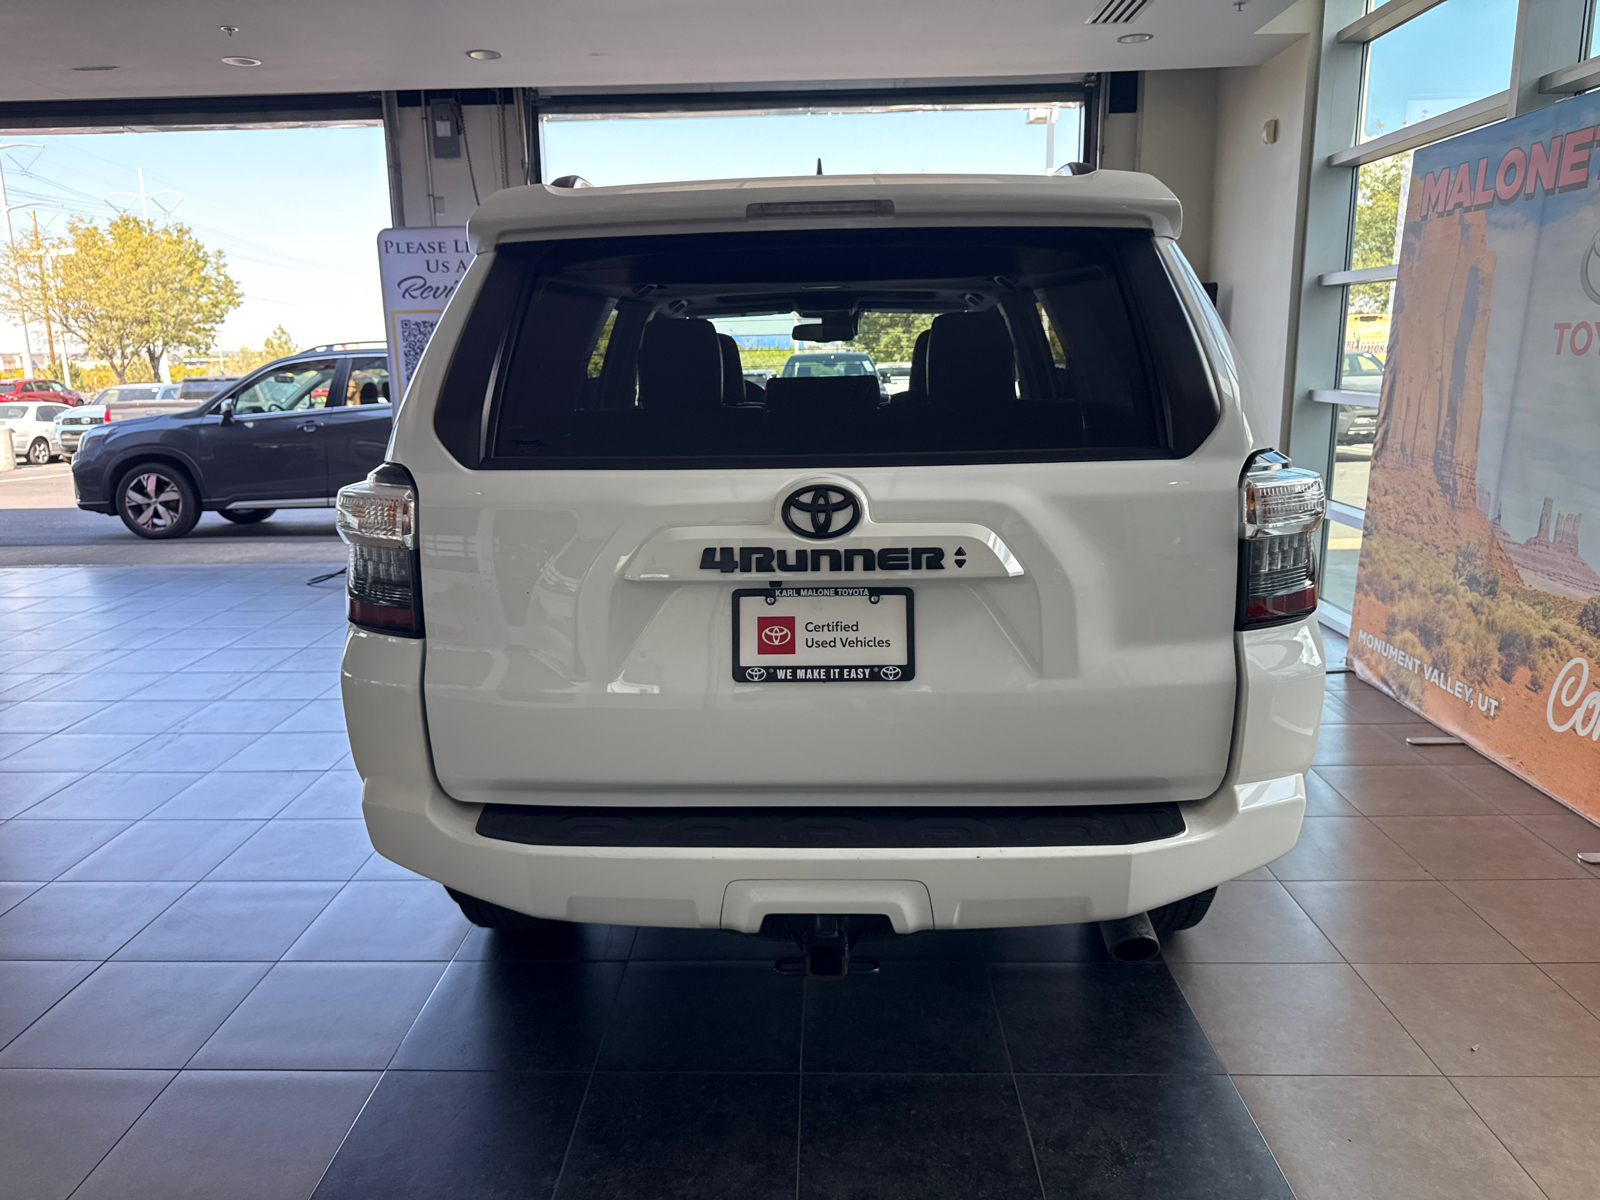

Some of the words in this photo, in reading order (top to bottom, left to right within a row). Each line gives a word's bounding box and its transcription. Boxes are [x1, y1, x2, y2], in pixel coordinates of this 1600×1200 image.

[1419, 125, 1594, 221] MALONE
[384, 240, 447, 254] PLEASE
[425, 259, 450, 273] US
[775, 589, 798, 597] KARL
[800, 589, 835, 597] MALONE
[837, 588, 869, 596] TOYOTA
[804, 620, 859, 633] Certified
[805, 636, 836, 648] Used
[839, 636, 891, 648] Vehicles
[776, 669, 792, 680] WE
[796, 668, 826, 680] MAKE
[830, 668, 840, 679] IT
[843, 668, 870, 679] EASY
[1358, 629, 1420, 674] MONUMENT
[1423, 663, 1474, 708] VALLEY,
[1478, 692, 1499, 717] UT
